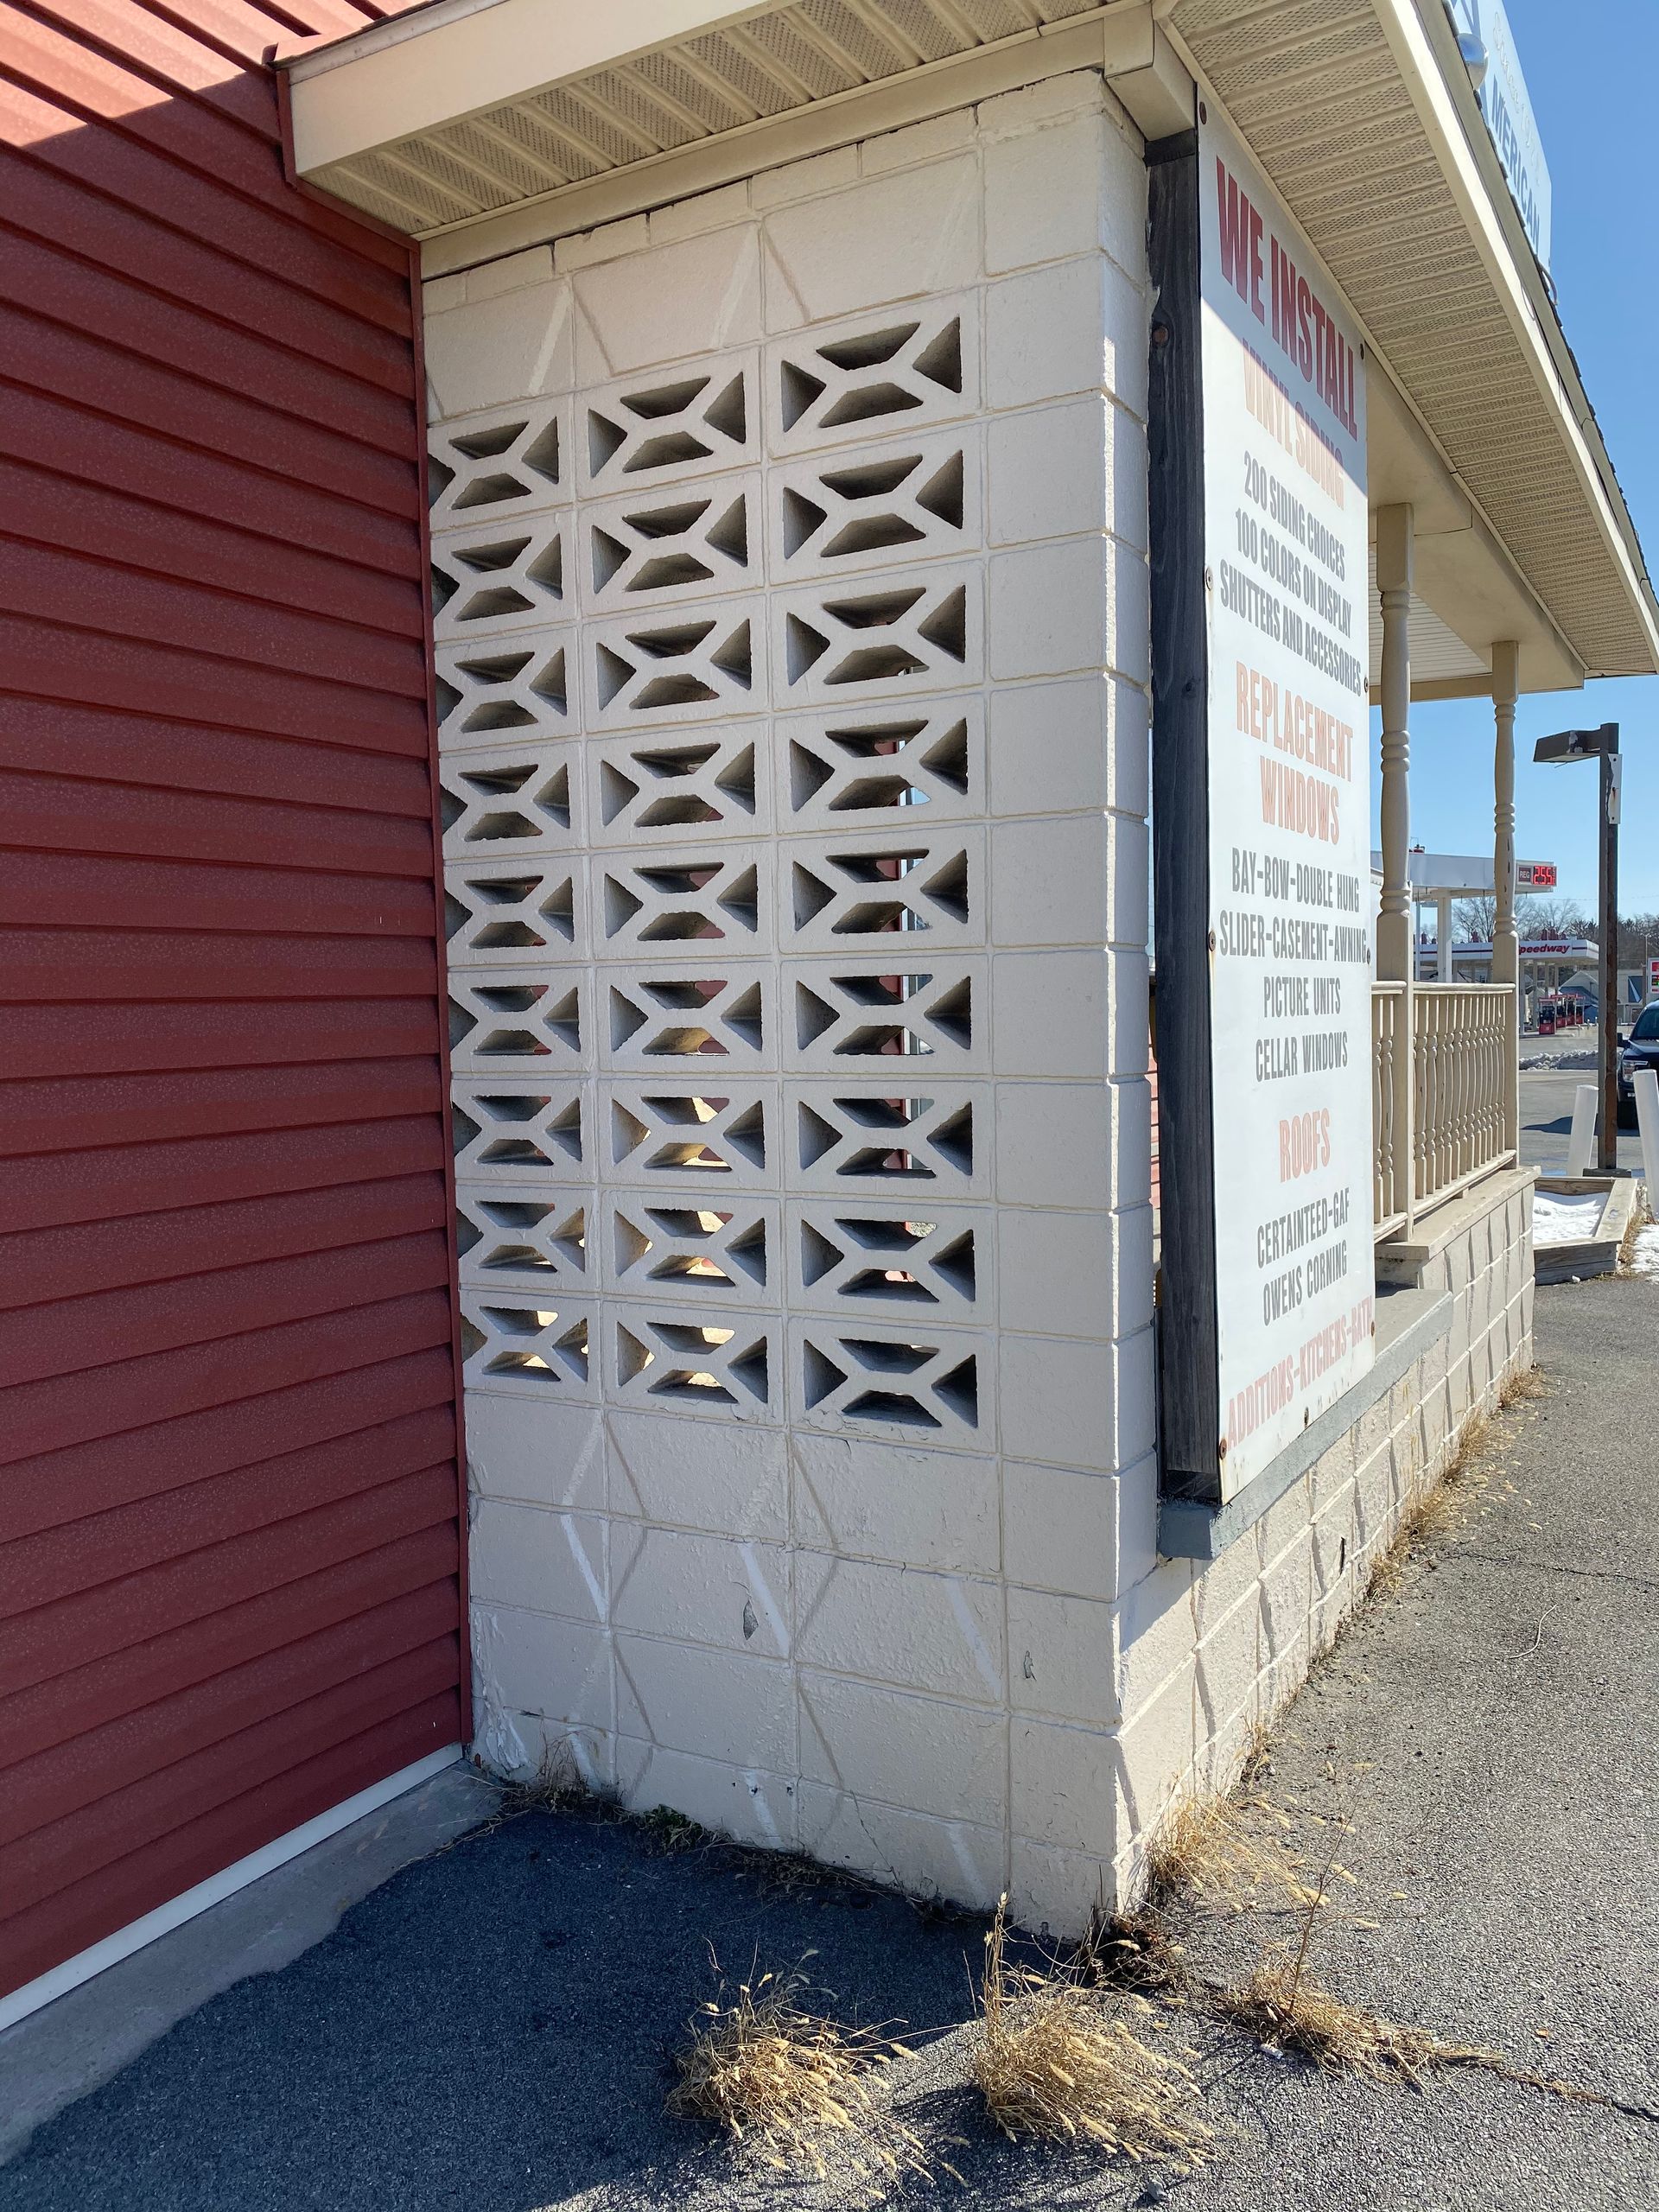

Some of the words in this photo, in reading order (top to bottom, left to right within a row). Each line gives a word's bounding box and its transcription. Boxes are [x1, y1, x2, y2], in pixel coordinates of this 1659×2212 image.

[1216, 156, 1265, 326] WE
[1271, 233, 1357, 442] INSTALL
[1242, 338, 1294, 457] VINYL
[1295, 401, 1344, 510] SIDING
[1244, 450, 1268, 512] 200
[1269, 475, 1306, 546] SIDING
[1307, 512, 1345, 582] CHOICES
[1236, 507, 1258, 564] 100
[1261, 527, 1301, 599] COLORS
[1303, 564, 1317, 611] ON
[1318, 578, 1351, 639] DISPLAY
[1220, 559, 1281, 642] SHUTTERS
[1282, 605, 1303, 657] AND
[1305, 621, 1362, 697] ACCESSORIES
[1236, 660, 1353, 782] REPLACEMENT
[1260, 755, 1340, 845] WINDOWS
[1231, 847, 1333, 909] BAY-BOW-DOUBLE
[1337, 873, 1360, 913] HUNG
[1519, 870, 1530, 880] REG
[1219, 910, 1367, 963] SLIDER-CASEMENT-AWNING
[1518, 944, 1571, 956] peedway
[1263, 976, 1309, 1018] PICTURE
[1313, 977, 1341, 1015] UNITS
[1255, 1037, 1298, 1083] CELLAR
[1302, 1031, 1348, 1074] WINDOWS
[1279, 1108, 1330, 1183] ROOFS
[1257, 1187, 1350, 1269] CERTAINTEED-GAF
[1263, 1265, 1302, 1327] OWENS
[1306, 1239, 1348, 1299] CORNING
